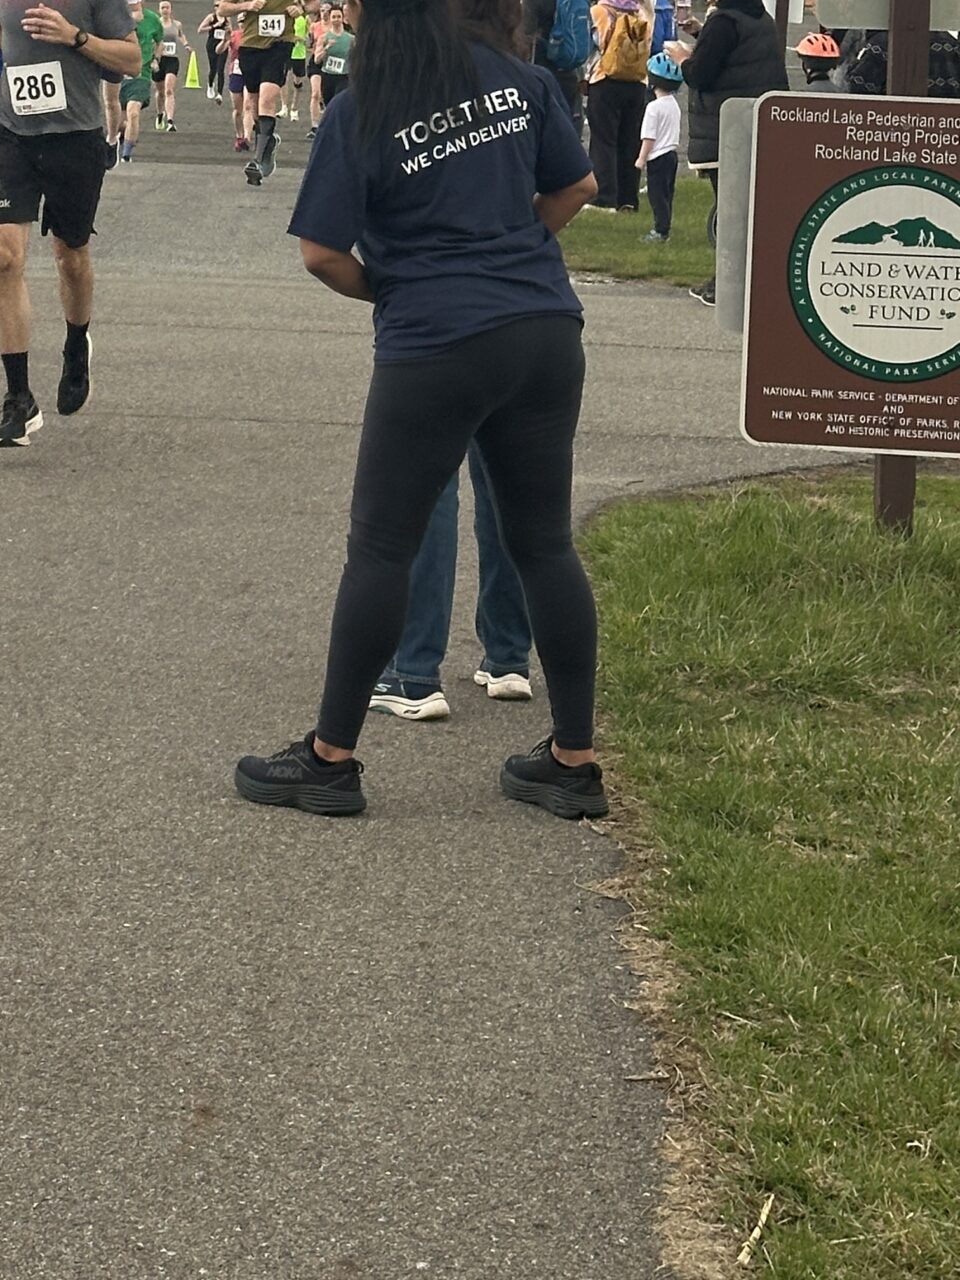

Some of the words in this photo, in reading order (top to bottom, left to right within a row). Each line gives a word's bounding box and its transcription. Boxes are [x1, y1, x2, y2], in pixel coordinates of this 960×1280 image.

[261, 18, 281, 31] 341
[13, 73, 56, 101] 286
[771, 106, 830, 123] Rockland
[833, 109, 863, 125] Lake
[867, 111, 935, 129] Pedestrian
[846, 126, 910, 147] Repaving
[401, 152, 432, 175] WE
[433, 136, 467, 160] CAN
[815, 144, 879, 161] Rockland
[883, 147, 917, 163] Lake
[921, 148, 957, 165] State
[808, 195, 838, 227] STATE
[842, 178, 867, 195] AND
[874, 172, 916, 181] LOCAL
[820, 261, 882, 278] LAND
[888, 263, 901, 279] &
[904, 264, 960, 281] WATE
[819, 282, 960, 302] CONSERVATIO
[868, 304, 931, 321] FUND
[818, 333, 877, 373] NATIONAL
[885, 367, 919, 376] PARK
[762, 386, 808, 398] NATIONAL
[811, 388, 834, 399] PARK
[837, 391, 875, 401] SERVICE
[885, 392, 943, 405] DEPARTMENT
[947, 396, 959, 406] OF
[771, 410, 792, 420] NEW
[797, 412, 823, 421] YORK
[827, 413, 855, 423] STATE
[899, 417, 913, 426] OF
[882, 405, 904, 414] AND
[825, 424, 845, 435] AND
[848, 426, 890, 437] HISTORIC
[894, 428, 960, 441] PRESERVATION
[266, 765, 303, 780] HOKA
